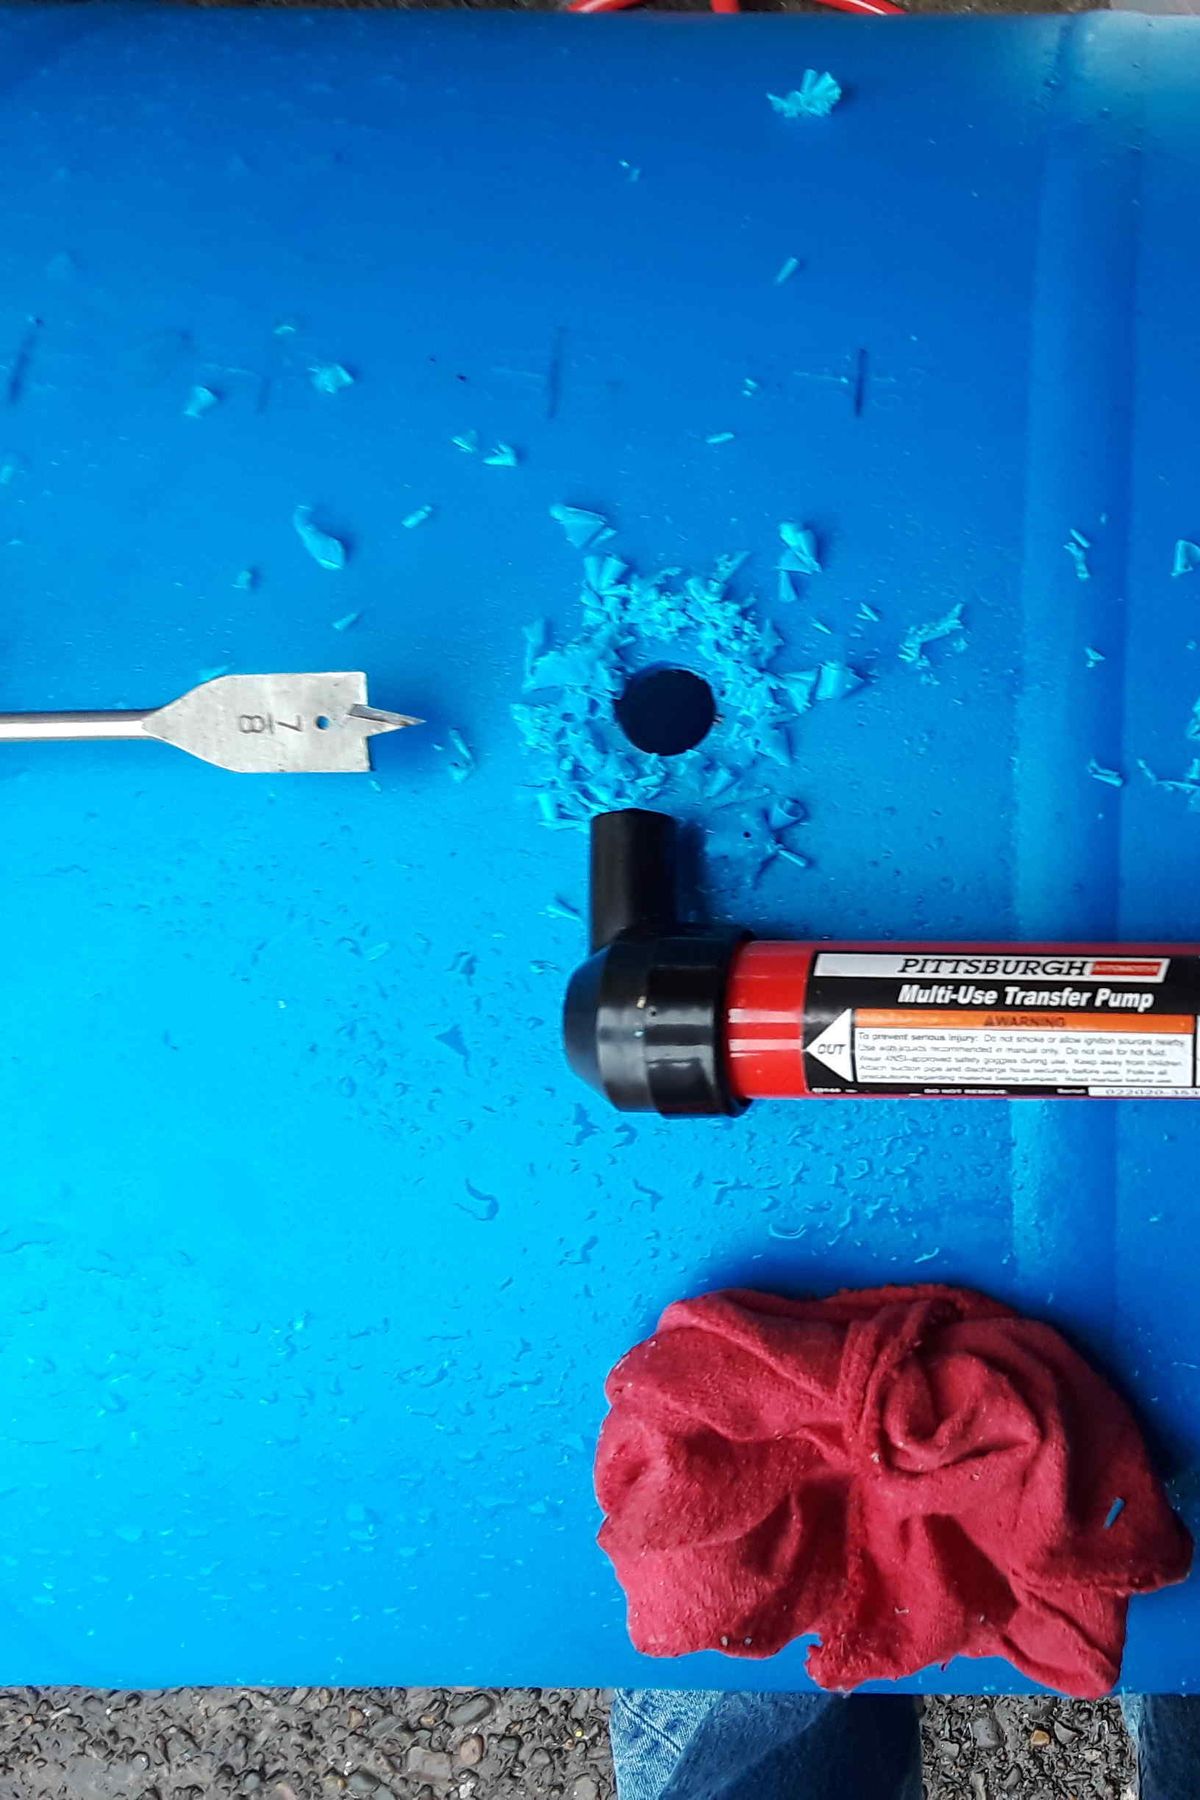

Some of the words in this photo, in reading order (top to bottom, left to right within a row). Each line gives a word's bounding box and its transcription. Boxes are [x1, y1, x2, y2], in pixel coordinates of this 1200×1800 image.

[239, 714, 265, 733] 8
[276, 713, 304, 732] 7
[897, 958, 1089, 976] PITTSBURGH
[898, 985, 998, 1004] Multi-Use
[1004, 987, 1091, 1006] Transfer
[1094, 988, 1154, 1012] Pump
[993, 1016, 1066, 1027] WARNING
[859, 1032, 869, 1040] To
[872, 1033, 908, 1042] prevent
[984, 1034, 996, 1042] Do
[1016, 1035, 1044, 1043] smoke
[1059, 1036, 1081, 1044] allow
[1084, 1037, 1116, 1046] ignition
[817, 1043, 847, 1055] OUT
[1066, 1047, 1079, 1055] Do
[1130, 1048, 1144, 1056] hot
